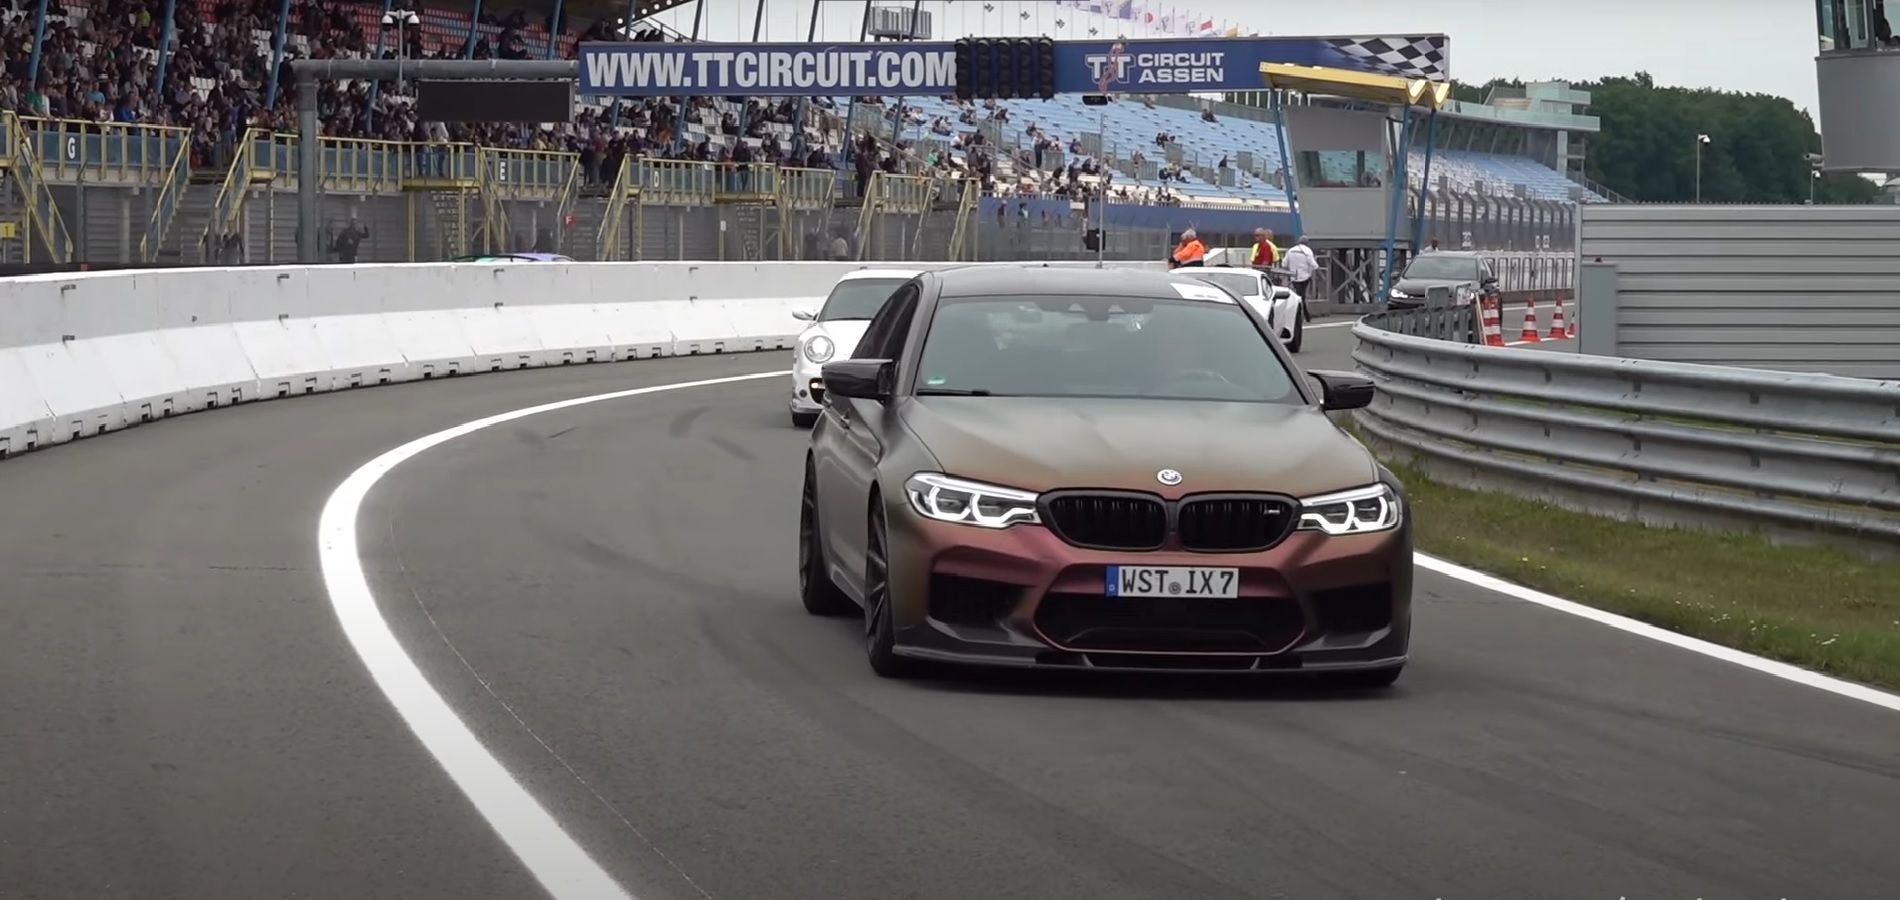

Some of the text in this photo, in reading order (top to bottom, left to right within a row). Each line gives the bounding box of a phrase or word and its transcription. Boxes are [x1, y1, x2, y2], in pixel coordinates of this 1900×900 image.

[586, 51, 957, 88] WWW.TTCIRCUIT.COM
[1138, 53, 1224, 67] CIRCUIT
[1138, 68, 1224, 83] ASSEN
[67, 137, 76, 159] G
[500, 161, 506, 180] E
[1122, 569, 1169, 593] WST
